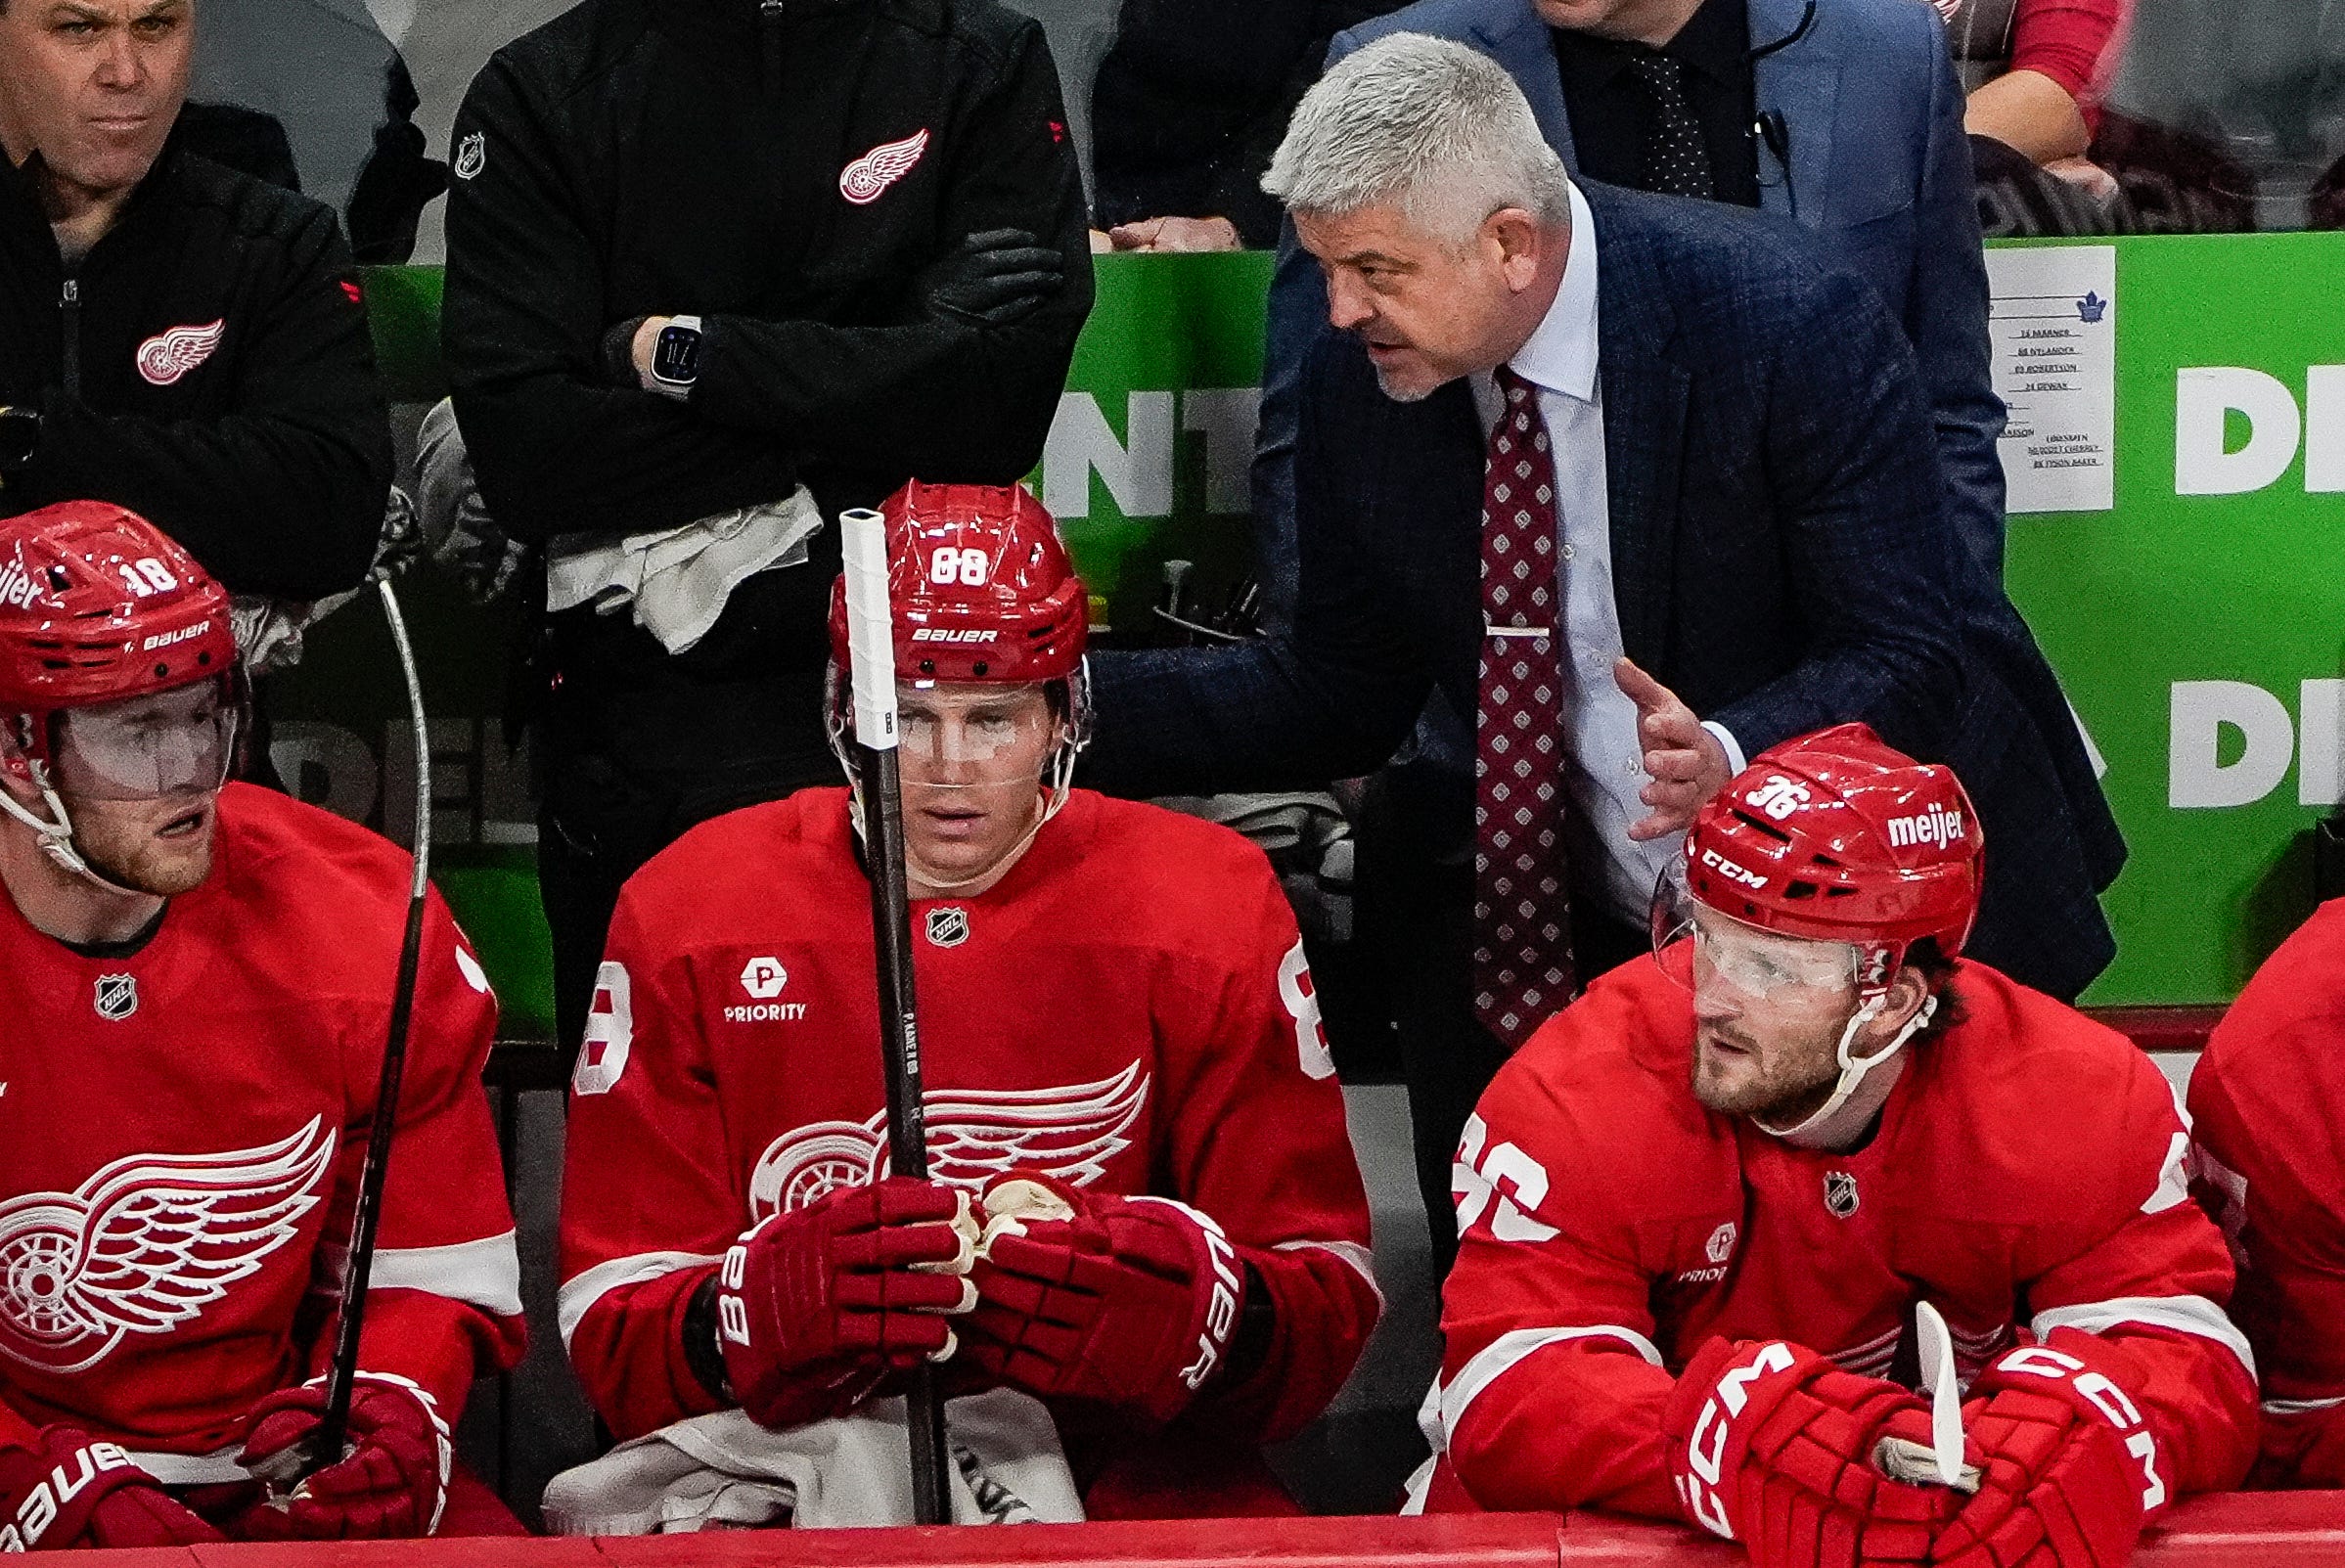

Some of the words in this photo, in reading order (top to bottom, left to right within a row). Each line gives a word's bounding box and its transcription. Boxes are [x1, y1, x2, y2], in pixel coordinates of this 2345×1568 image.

[118, 558, 178, 598] 18
[930, 547, 988, 587] 88
[143, 620, 210, 651] BAUER
[912, 628, 998, 643] BAUER
[1745, 775, 1811, 820] 36
[1701, 848, 1769, 889] CCM
[935, 918, 960, 940] NHL
[756, 966, 774, 990] P
[104, 985, 128, 1010] NHL
[724, 1003, 806, 1022] PRIORITY
[1688, 1342, 1795, 1540] CCM
[1997, 1347, 2166, 1511] CCM
